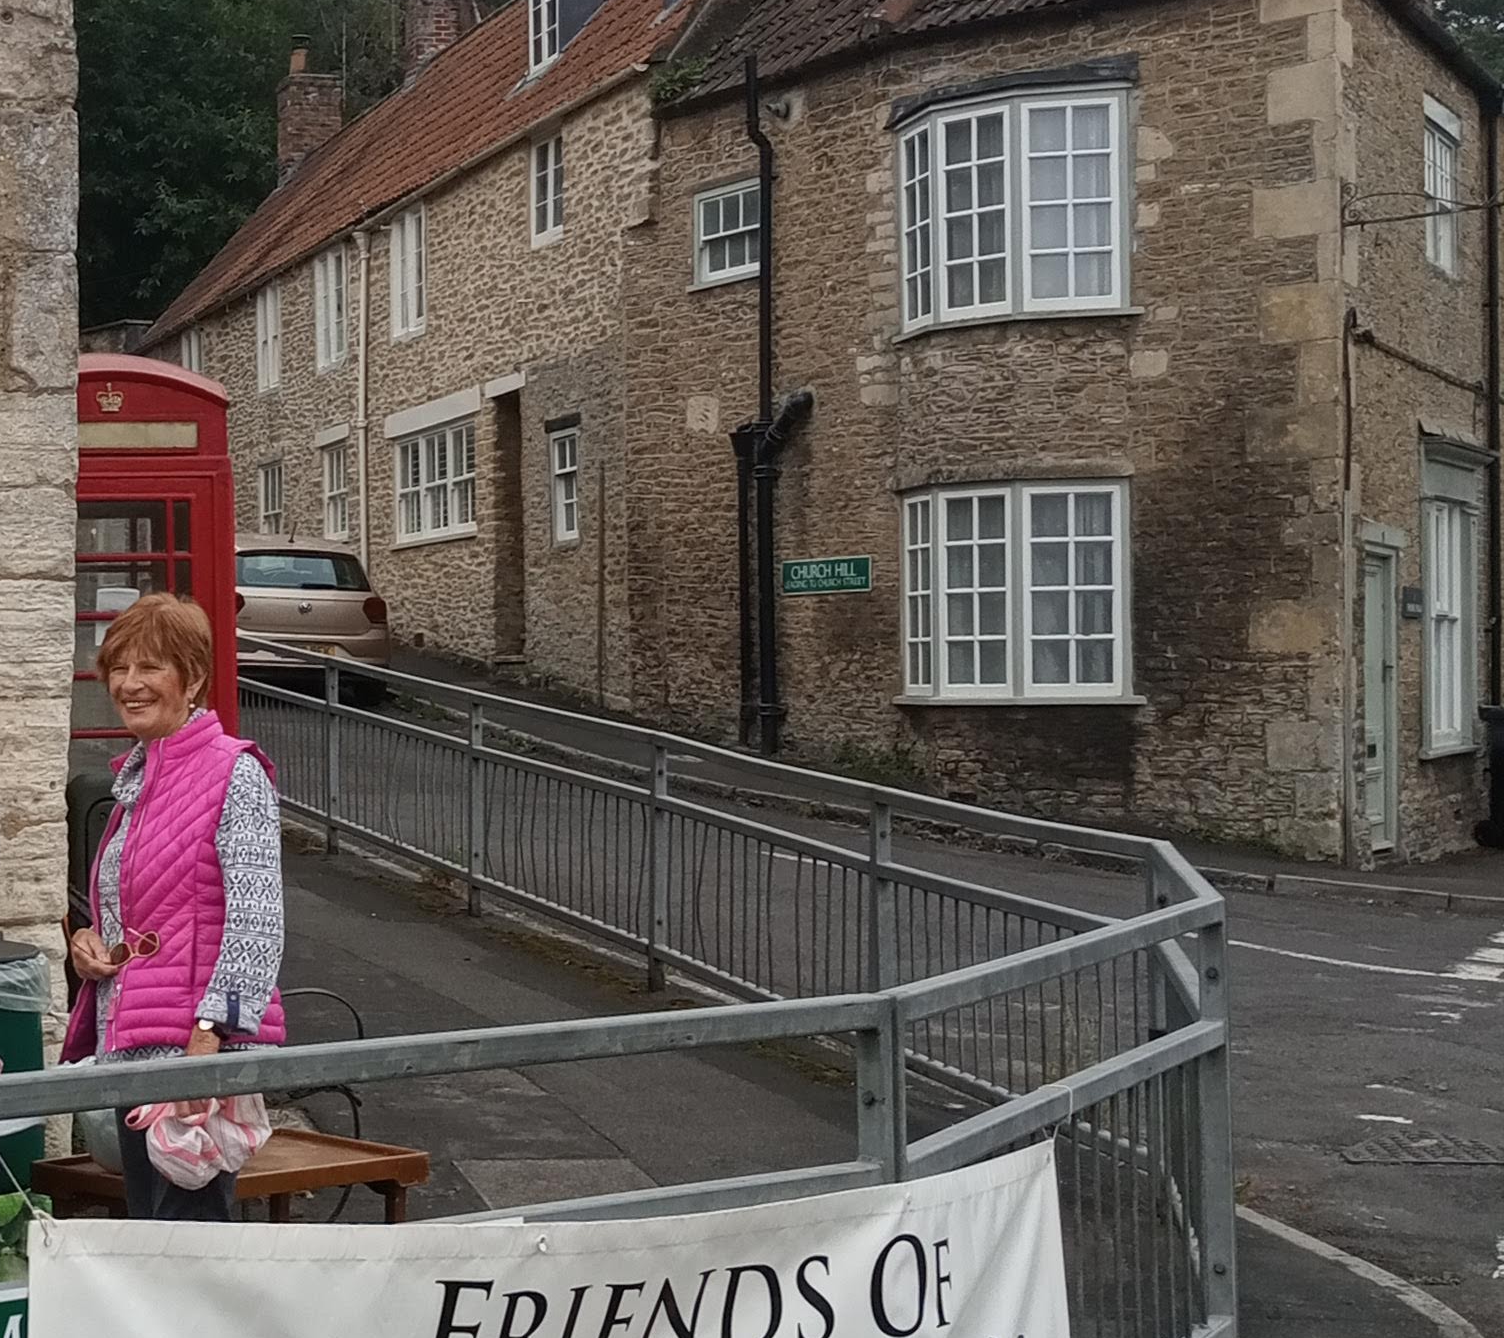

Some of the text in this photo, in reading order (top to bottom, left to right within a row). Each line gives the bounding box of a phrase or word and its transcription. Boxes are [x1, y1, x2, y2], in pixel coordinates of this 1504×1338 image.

[791, 562, 856, 579] CHURCH HILL
[869, 1232, 952, 1338] OF
